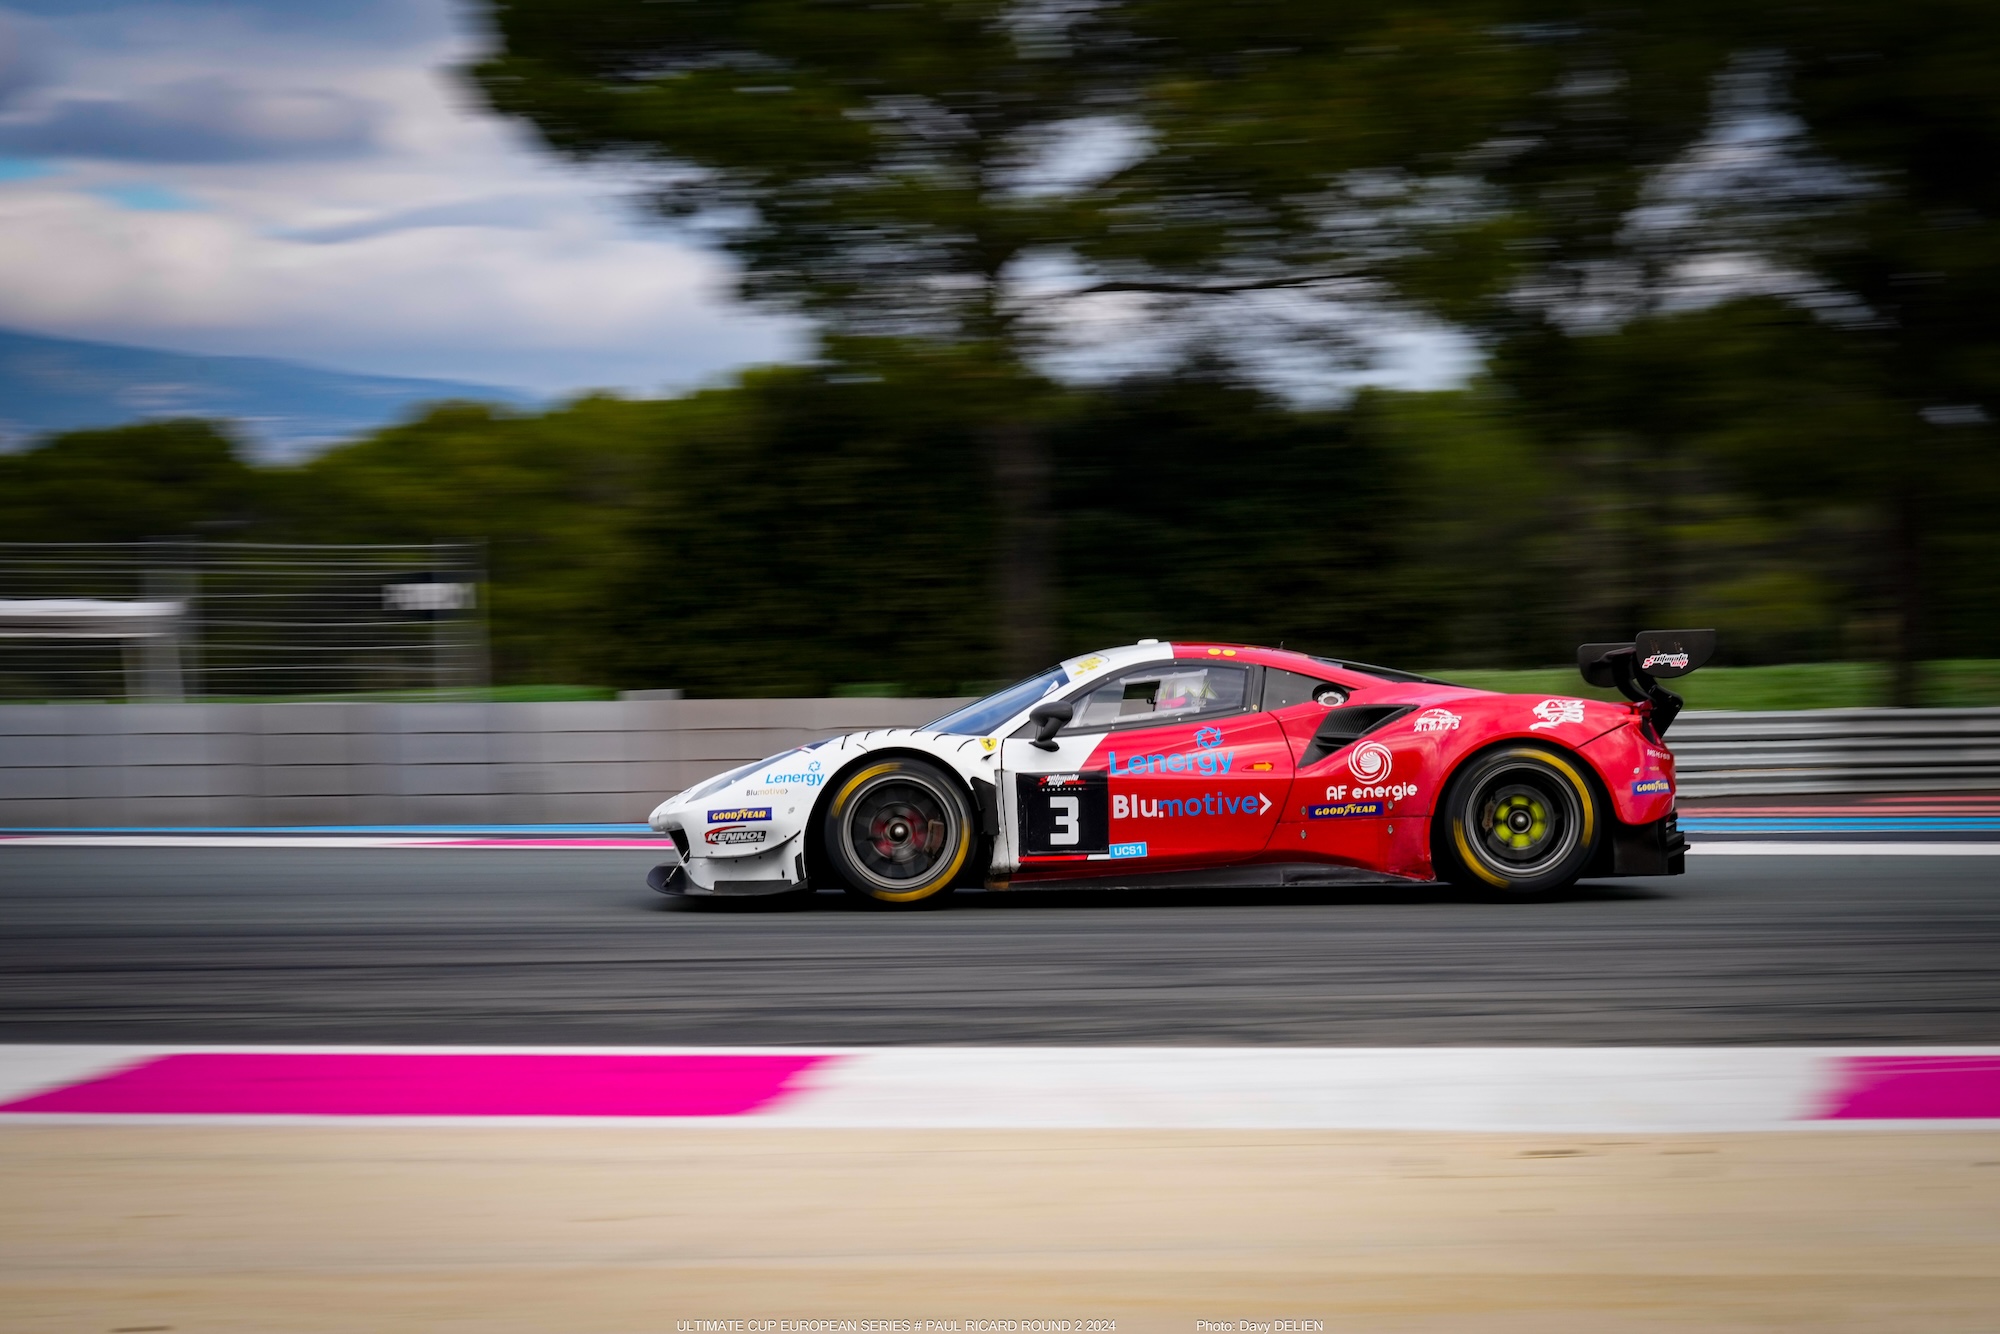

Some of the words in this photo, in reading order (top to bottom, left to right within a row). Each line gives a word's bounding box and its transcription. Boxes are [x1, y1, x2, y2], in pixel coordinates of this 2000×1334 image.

[1108, 751, 1234, 776] Lenergy
[765, 773, 825, 786] Lenergy
[1326, 784, 1348, 801] AF
[1352, 781, 1418, 801] energie
[712, 809, 766, 821] GOODYEAR
[1315, 803, 1377, 816] GOODYEAR
[1050, 796, 1079, 845] 3
[707, 831, 765, 842] KENNOL
[1114, 845, 1143, 856] UCS1
